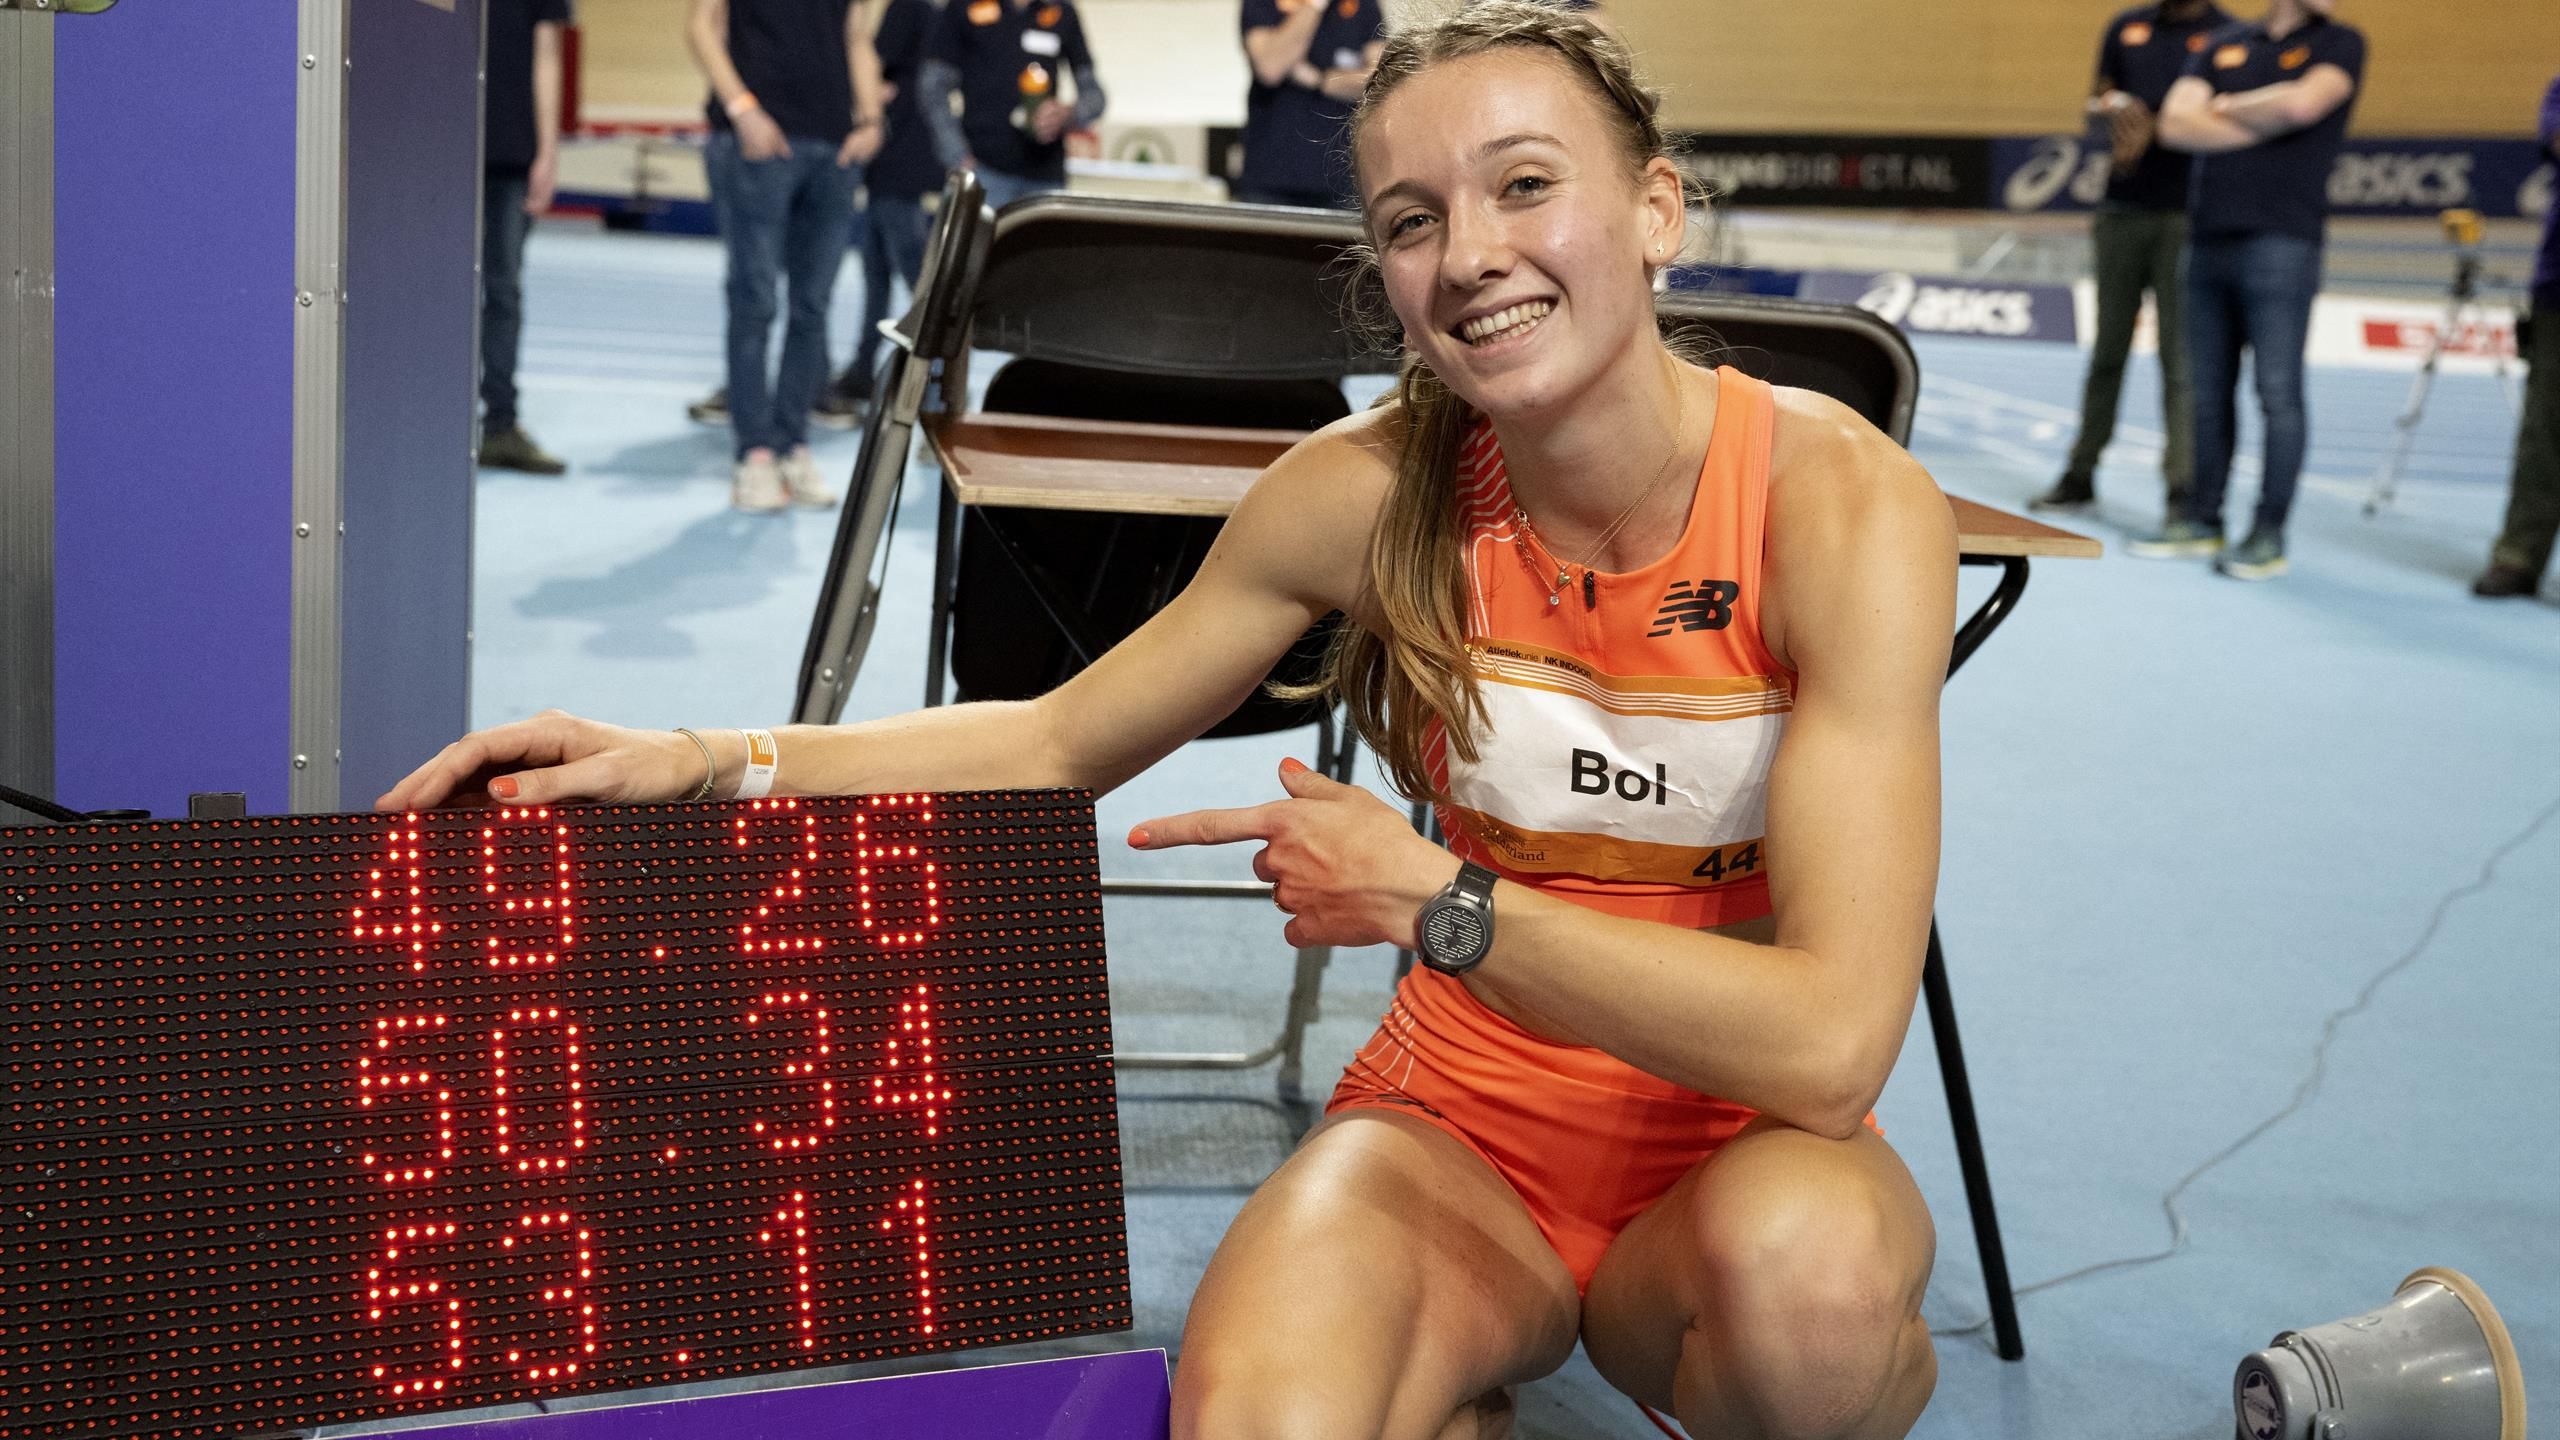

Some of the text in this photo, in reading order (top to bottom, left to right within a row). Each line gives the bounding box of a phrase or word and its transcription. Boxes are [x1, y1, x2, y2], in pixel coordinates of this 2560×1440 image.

[1907, 285, 2033, 335] asics
[1487, 646, 1539, 662] Atletiekunie
[1544, 656, 1558, 666] NK
[1571, 748, 1667, 806] Bol
[351, 790, 941, 974] 49.26
[1692, 842, 1760, 882] 44
[357, 981, 954, 1184] 50.34
[365, 1177, 937, 1395] 53.11
